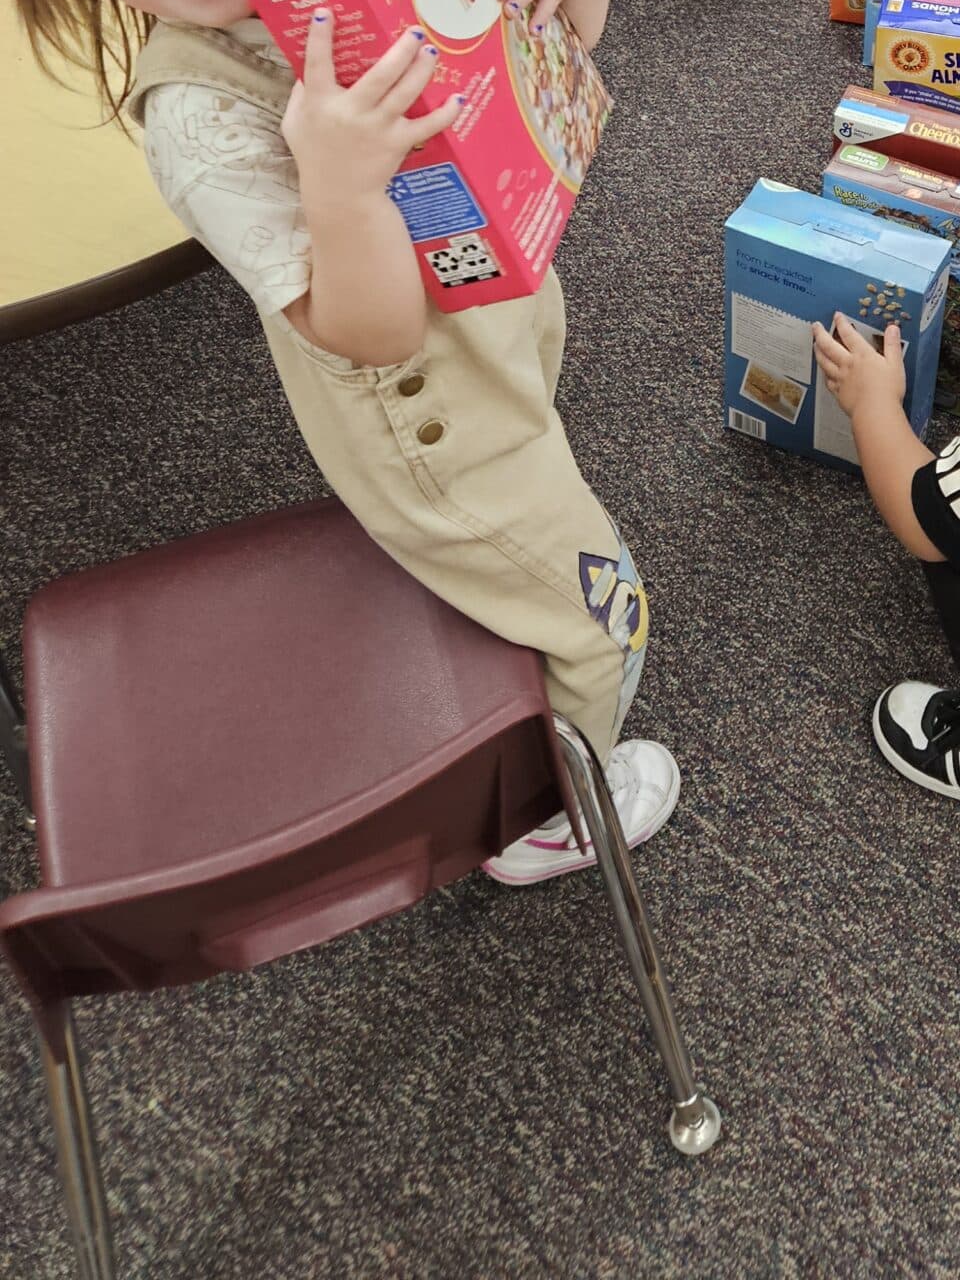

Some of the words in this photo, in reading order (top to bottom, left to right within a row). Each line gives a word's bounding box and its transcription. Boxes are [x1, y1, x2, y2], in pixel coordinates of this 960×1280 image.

[833, 185, 859, 200] Race
[736, 248, 762, 265] From
[763, 260, 813, 283] breakfast
[749, 266, 781, 283] snack
[782, 279, 816, 297] time...
